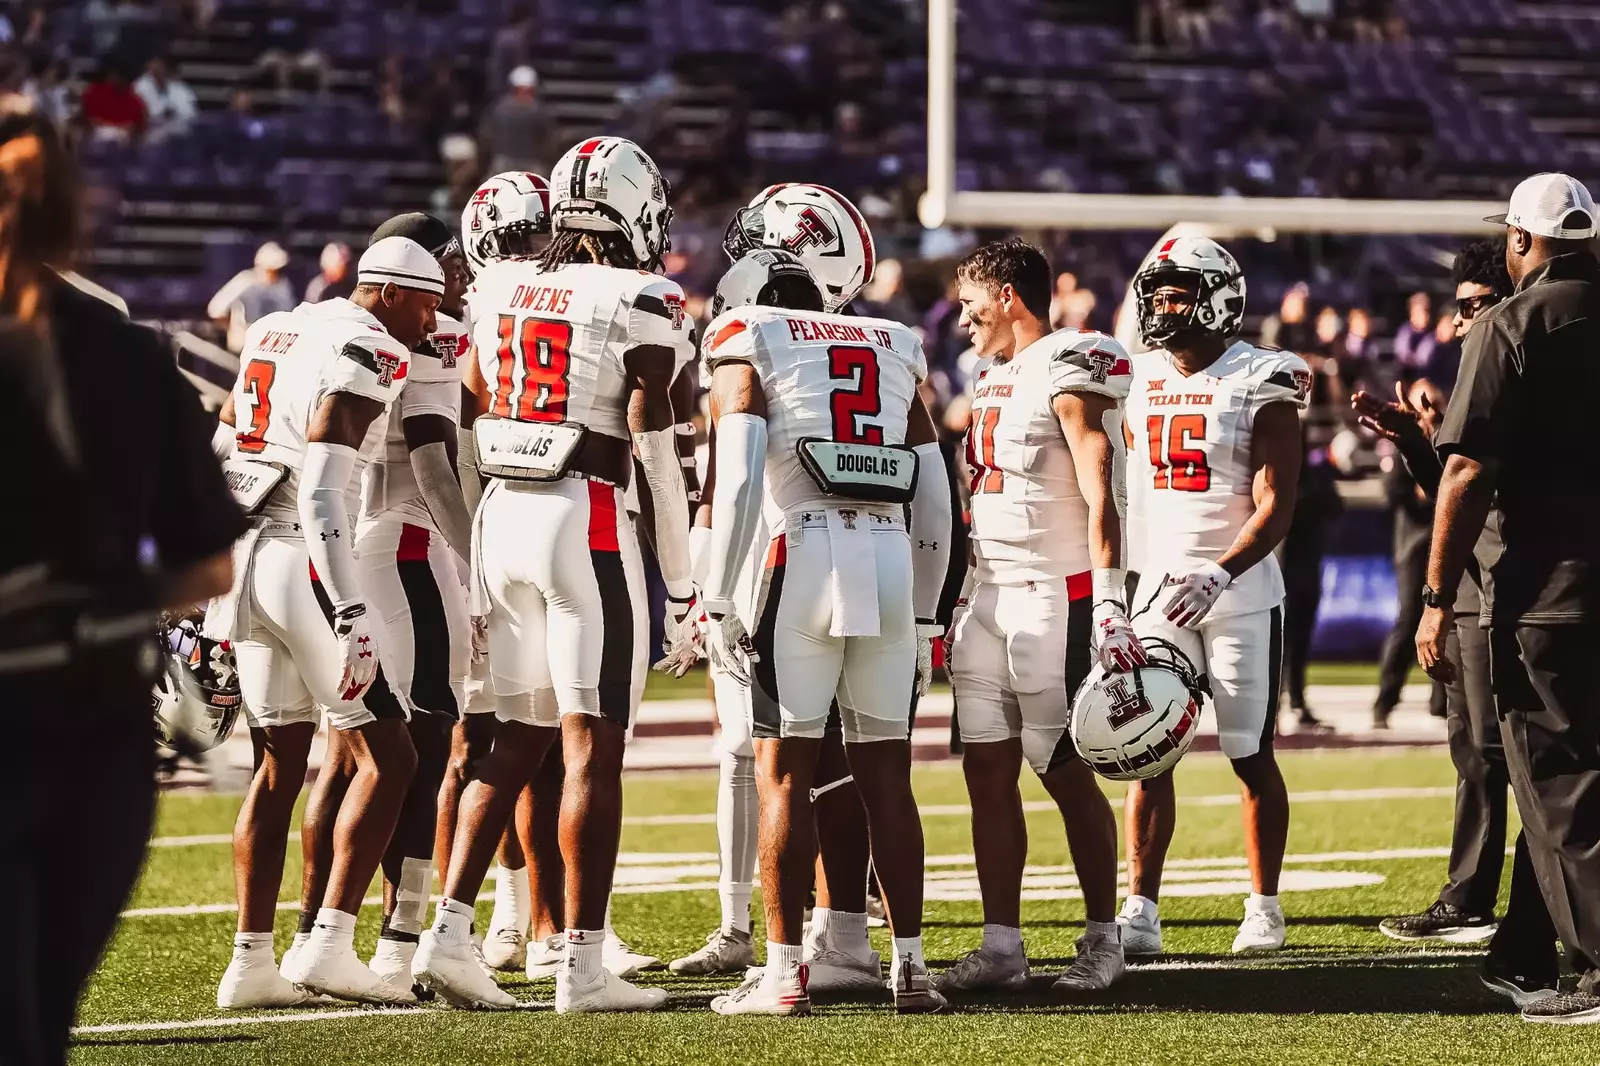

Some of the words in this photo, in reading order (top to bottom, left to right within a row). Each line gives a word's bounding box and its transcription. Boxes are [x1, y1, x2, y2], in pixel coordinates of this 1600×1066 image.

[509, 284, 573, 315] OWENS
[786, 318, 870, 343] PEARSON
[491, 313, 574, 424] 18
[827, 345, 884, 446] 2
[235, 358, 277, 454] 3
[1148, 394, 1182, 407] TEXAS
[1184, 394, 1214, 405] TECH
[836, 453, 898, 477] DOUGLAS
[1146, 414, 1211, 492] 16
